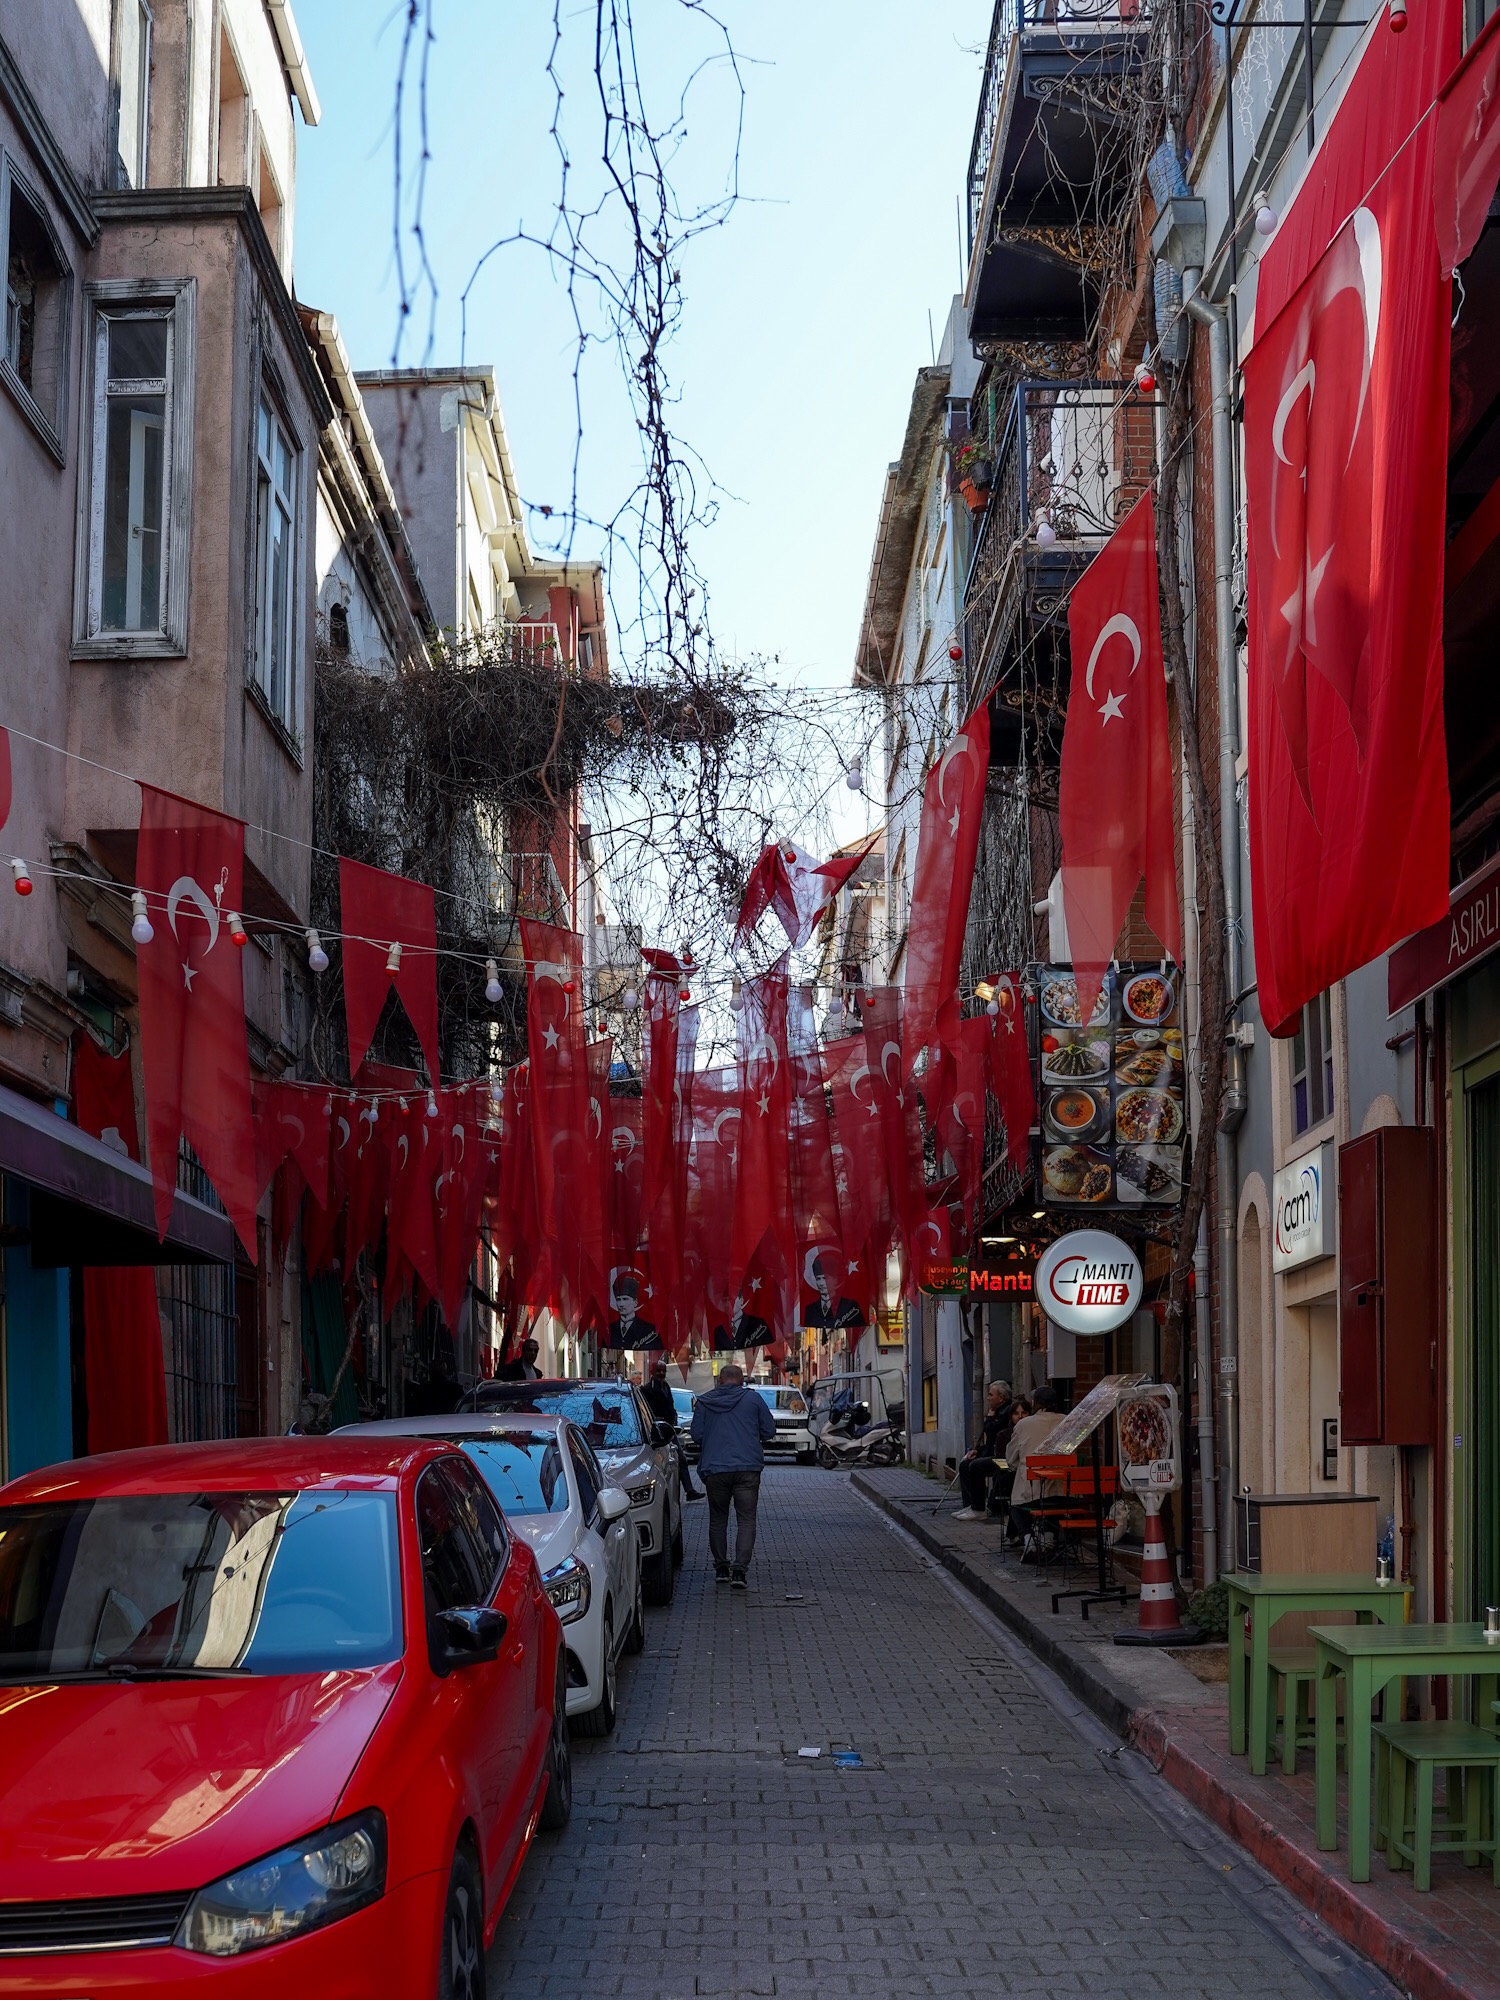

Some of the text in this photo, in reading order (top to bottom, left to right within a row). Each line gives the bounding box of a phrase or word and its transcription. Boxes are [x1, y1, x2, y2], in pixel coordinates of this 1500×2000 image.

[1284, 1190, 1310, 1232] ccm
[1082, 1263, 1134, 1280] MANTI
[1081, 1285, 1123, 1303] TIME
